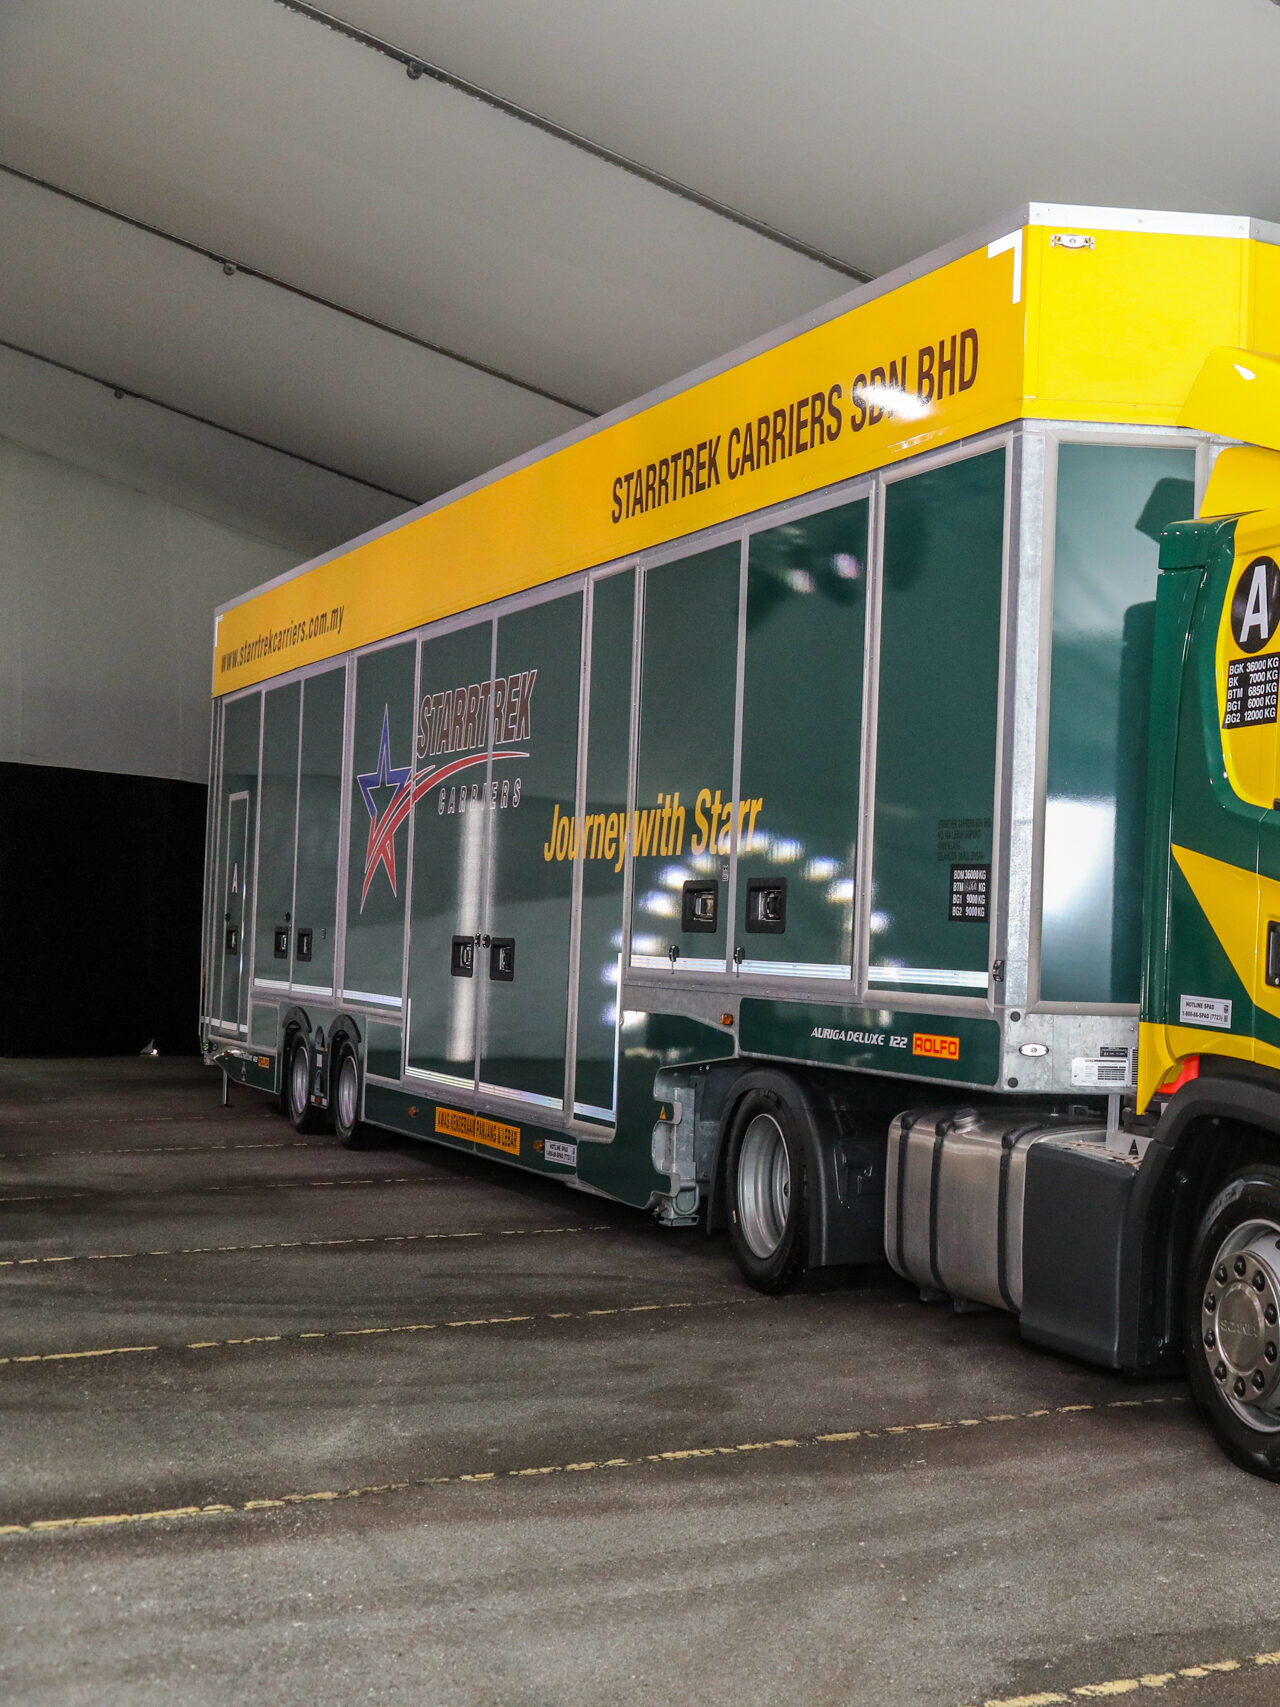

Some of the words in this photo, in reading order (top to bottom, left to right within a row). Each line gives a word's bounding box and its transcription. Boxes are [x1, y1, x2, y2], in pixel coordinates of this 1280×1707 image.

[611, 433, 722, 524] STARRTREK
[727, 383, 842, 480] CARRIERS
[916, 328, 979, 407] BHD
[1239, 564, 1269, 643] A
[221, 605, 344, 674] www.starrtrekcarriers.com.my
[1229, 663, 1244, 675] BGK
[1246, 659, 1266, 673] 36000
[1267, 656, 1279, 669] KG
[1228, 676, 1239, 687] BK
[1249, 671, 1266, 684] 7000
[1266, 669, 1278, 681] KG
[1227, 687, 1243, 700] BTM
[1247, 684, 1265, 697] 6850
[1265, 682, 1278, 694] KG
[1226, 700, 1241, 712] BG1
[1247, 696, 1264, 709] 6000
[1264, 694, 1277, 706] KG
[417, 669, 538, 759] STARRTREK
[1225, 712, 1240, 724] BG2
[1244, 709, 1264, 722] 12000
[1264, 707, 1276, 719] KG
[438, 777, 522, 816] CARRIERS
[544, 803, 632, 873] Journey
[633, 792, 686, 857] with
[691, 788, 763, 856] Starr
[1185, 1001, 1203, 1010] HOTLINE
[811, 1027, 846, 1041] AURIGA
[847, 1031, 885, 1046] DELUXE
[889, 1035, 908, 1049] 122
[914, 1036, 958, 1056] ROLFO
